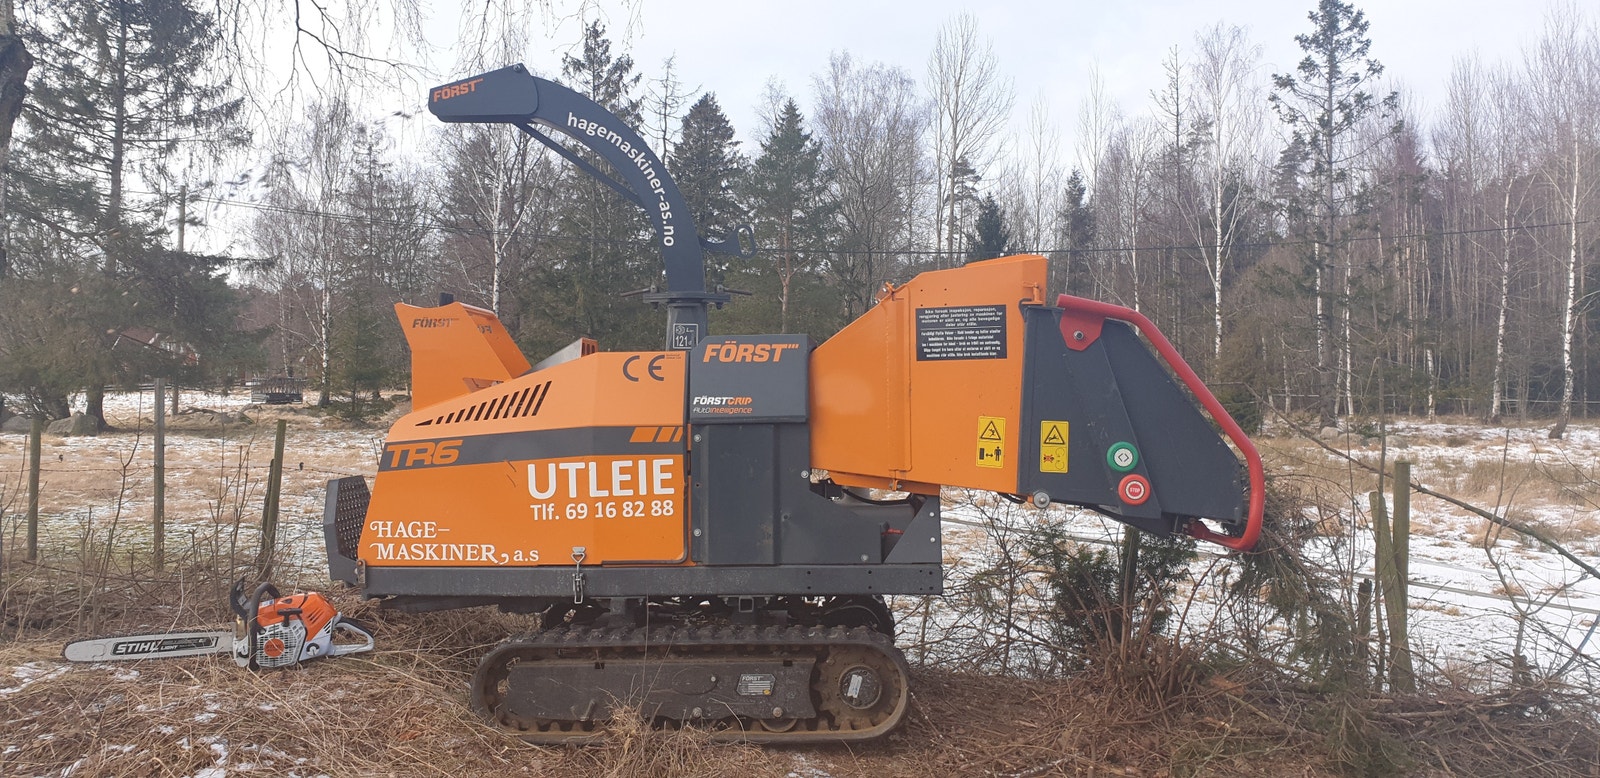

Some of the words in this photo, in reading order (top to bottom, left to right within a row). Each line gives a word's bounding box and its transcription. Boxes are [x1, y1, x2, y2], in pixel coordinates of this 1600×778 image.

[433, 79, 481, 102] FÖRST
[567, 112, 675, 247] hagemaskiner-as.no
[675, 335, 688, 346] 121
[703, 341, 798, 362] FÖRST
[623, 354, 665, 382] CE
[386, 440, 463, 468] TR6
[527, 458, 675, 500] UTLEIE
[530, 503, 560, 520] Tlf.
[565, 503, 588, 520] 69
[595, 502, 617, 518] 16
[622, 501, 645, 518] 82
[651, 500, 674, 517] 88
[116, 642, 159, 654] STIHL
